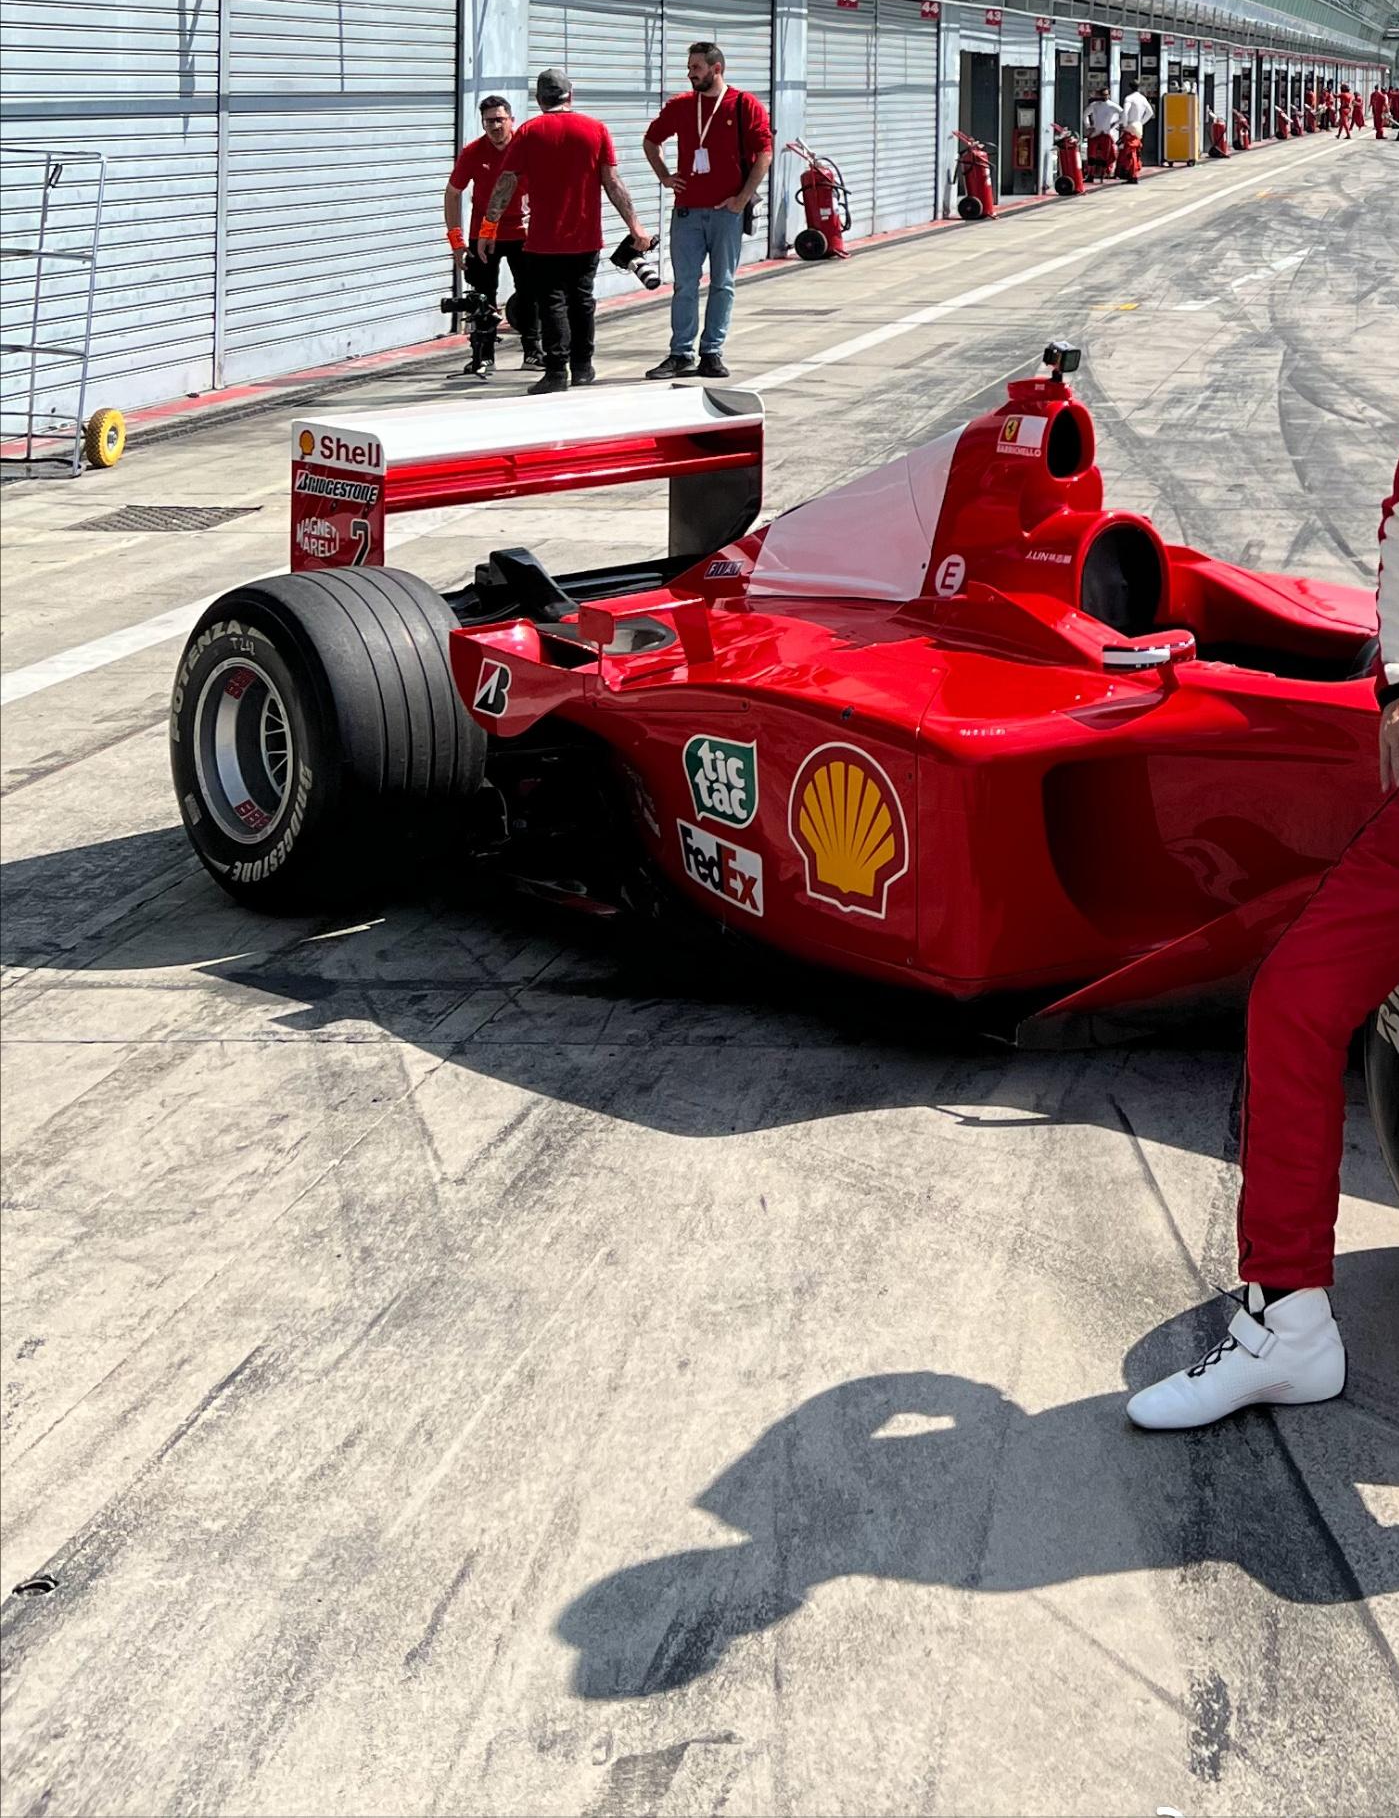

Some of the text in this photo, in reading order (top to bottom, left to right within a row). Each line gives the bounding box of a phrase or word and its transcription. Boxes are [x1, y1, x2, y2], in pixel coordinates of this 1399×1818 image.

[922, 1, 939, 14] 44
[986, 10, 1002, 22] 43
[1036, 18, 1050, 28] 42
[320, 435, 380, 468] Shell
[295, 470, 379, 505] BRIDGESTONE
[706, 561, 742, 577] FIAT
[941, 562, 961, 590] E
[171, 620, 242, 743] POTENZA
[697, 741, 745, 784] tic
[694, 768, 747, 819] tac
[231, 758, 313, 883] BRIDGESTONE
[678, 822, 761, 912] FedEx
